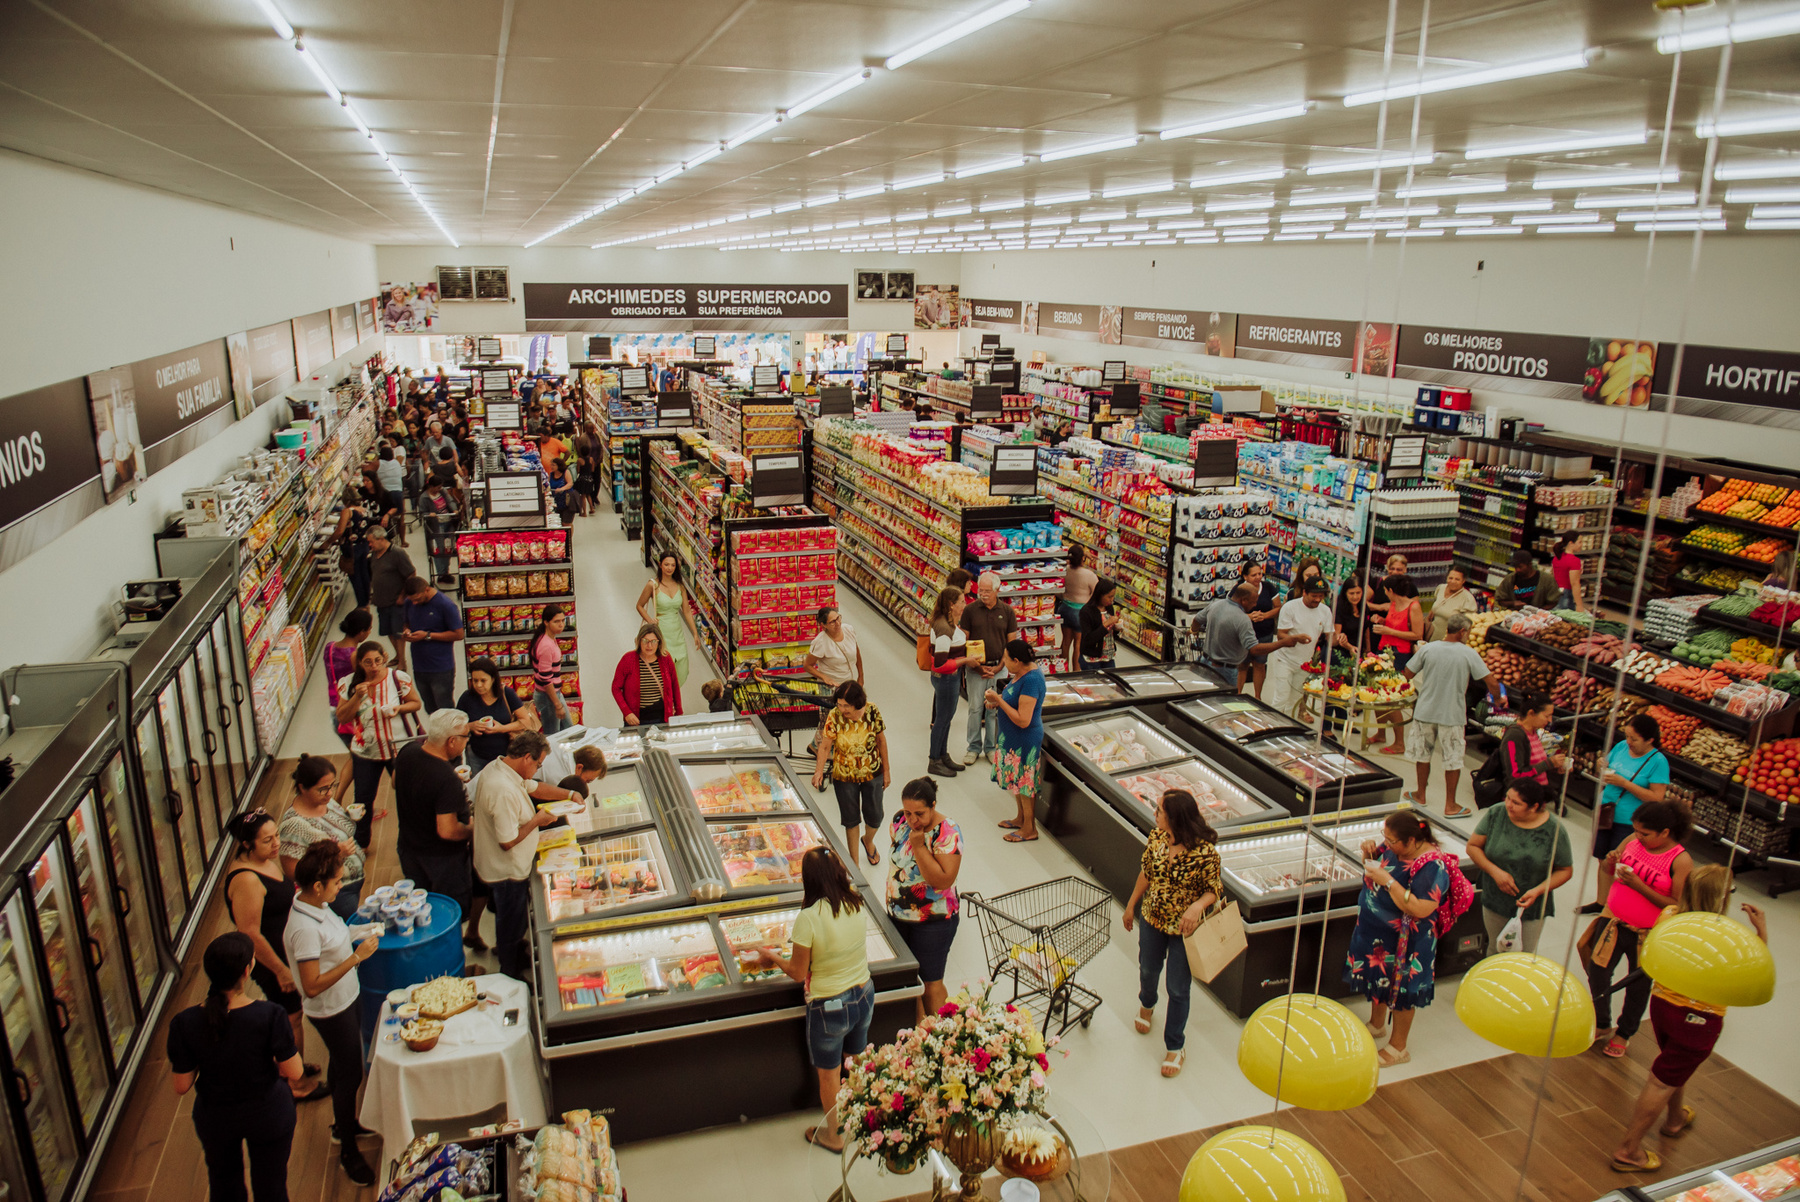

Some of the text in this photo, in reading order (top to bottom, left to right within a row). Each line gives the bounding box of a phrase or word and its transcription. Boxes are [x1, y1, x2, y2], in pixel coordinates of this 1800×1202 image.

[568, 288, 832, 305] ARCHIMEDES SUPERMERCADO
[611, 305, 783, 316] OBRIGADO PELA SUA PREFERÊNCIA
[974, 305, 1014, 319] SEJA BEM-VINDO
[1053, 310, 1083, 325] BEBIDAS
[1133, 311, 1188, 325] SEMPRE PENSANDO
[1158, 324, 1195, 341] EM VOCÊ
[1249, 325, 1342, 348] REFRIGERANTES
[1423, 331, 1503, 351] OS MELHORES
[1452, 350, 1549, 379] PRODUTOS
[156, 356, 201, 389] O MELHOR PARA
[1705, 363, 1800, 395] HORTIF
[176, 387, 196, 420] SUA
[0, 430, 46, 489] NIOS
[1208, 509, 1220, 519] 60
[1233, 508, 1245, 518] 60
[1259, 505, 1270, 515] 60
[1208, 528, 1220, 538] 60
[1232, 527, 1244, 537] 60
[1255, 527, 1266, 537] 60
[1204, 554, 1215, 564] 60
[1230, 552, 1241, 562] 60
[1255, 551, 1266, 561] 60
[1202, 573, 1213, 583] 60
[1228, 569, 1239, 579] 60
[1202, 591, 1213, 600] 60
[1620, 854, 1662, 887] CTIVE
